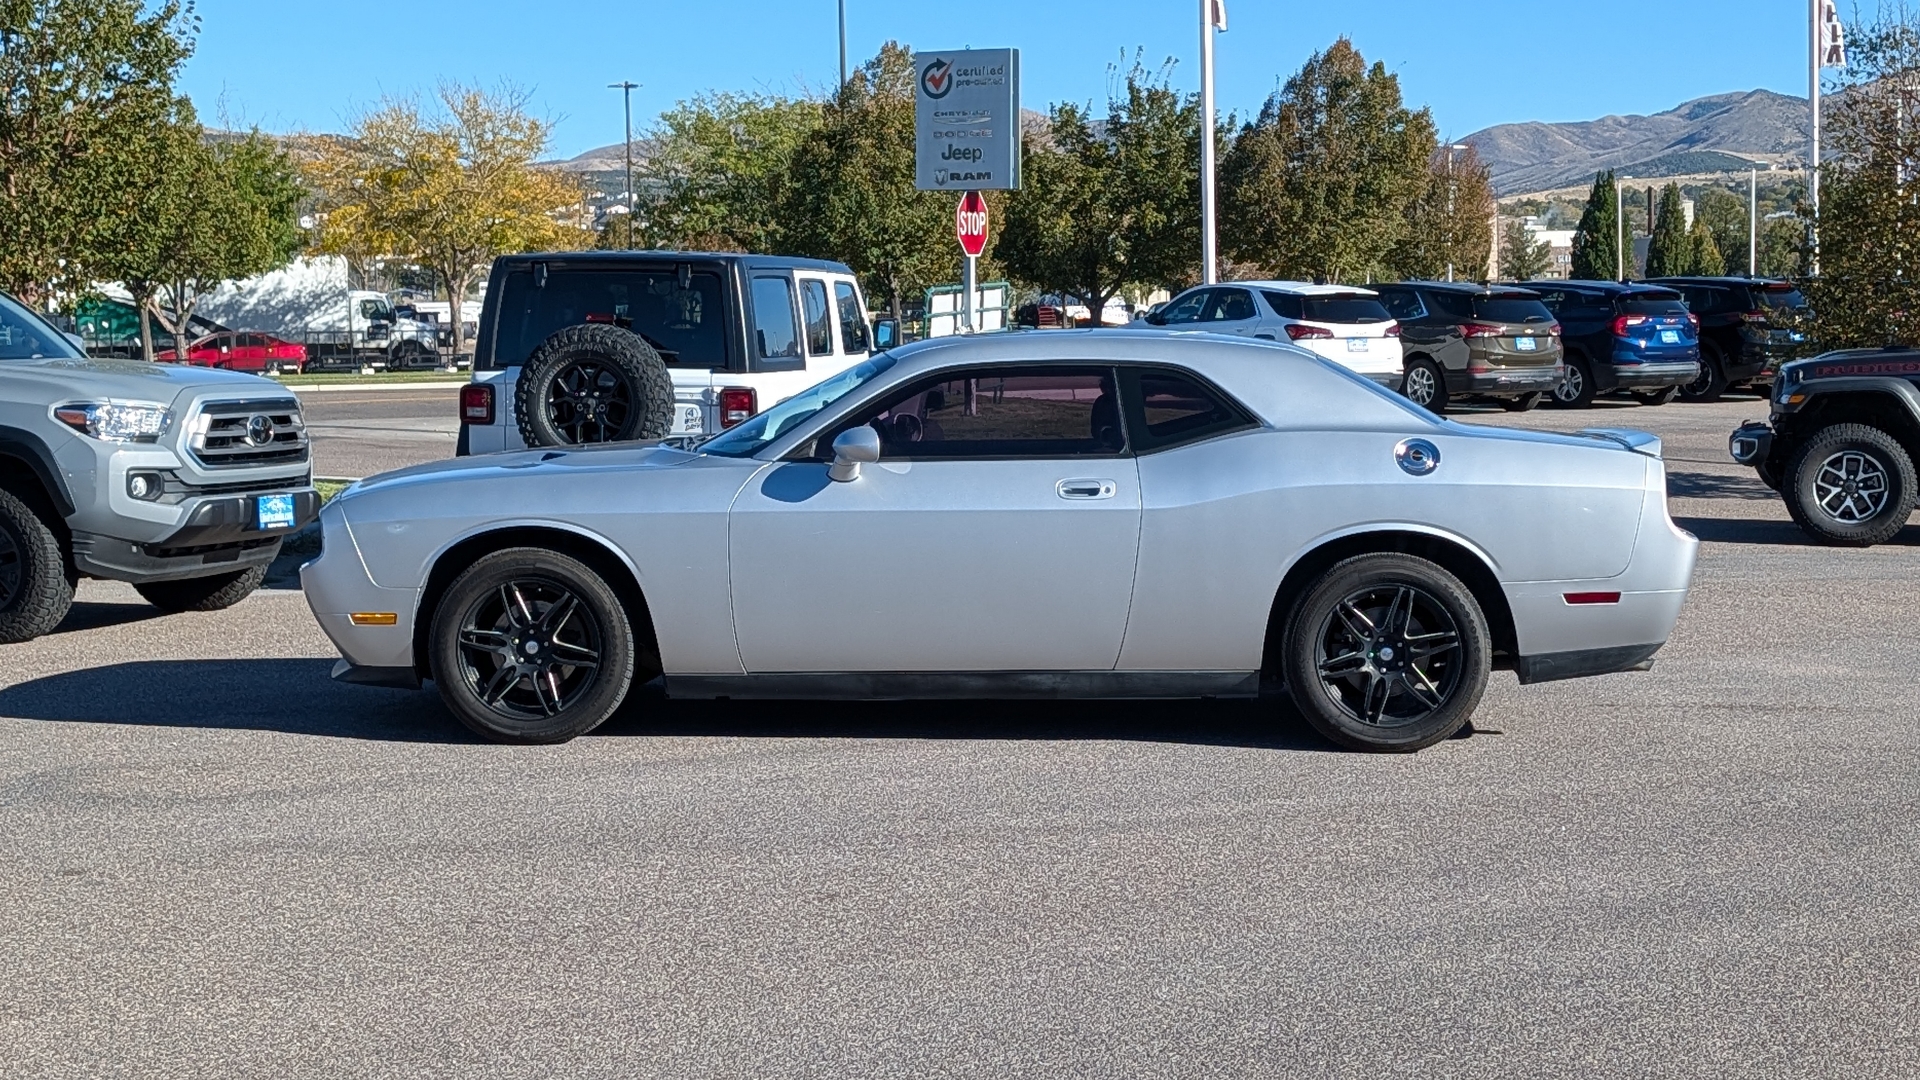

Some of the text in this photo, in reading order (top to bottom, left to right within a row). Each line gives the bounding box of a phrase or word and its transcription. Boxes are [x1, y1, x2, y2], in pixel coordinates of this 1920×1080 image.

[956, 65, 1004, 77] certified
[941, 143, 983, 163] Jeep
[950, 171, 993, 181] RAM
[960, 210, 986, 236] STOP
